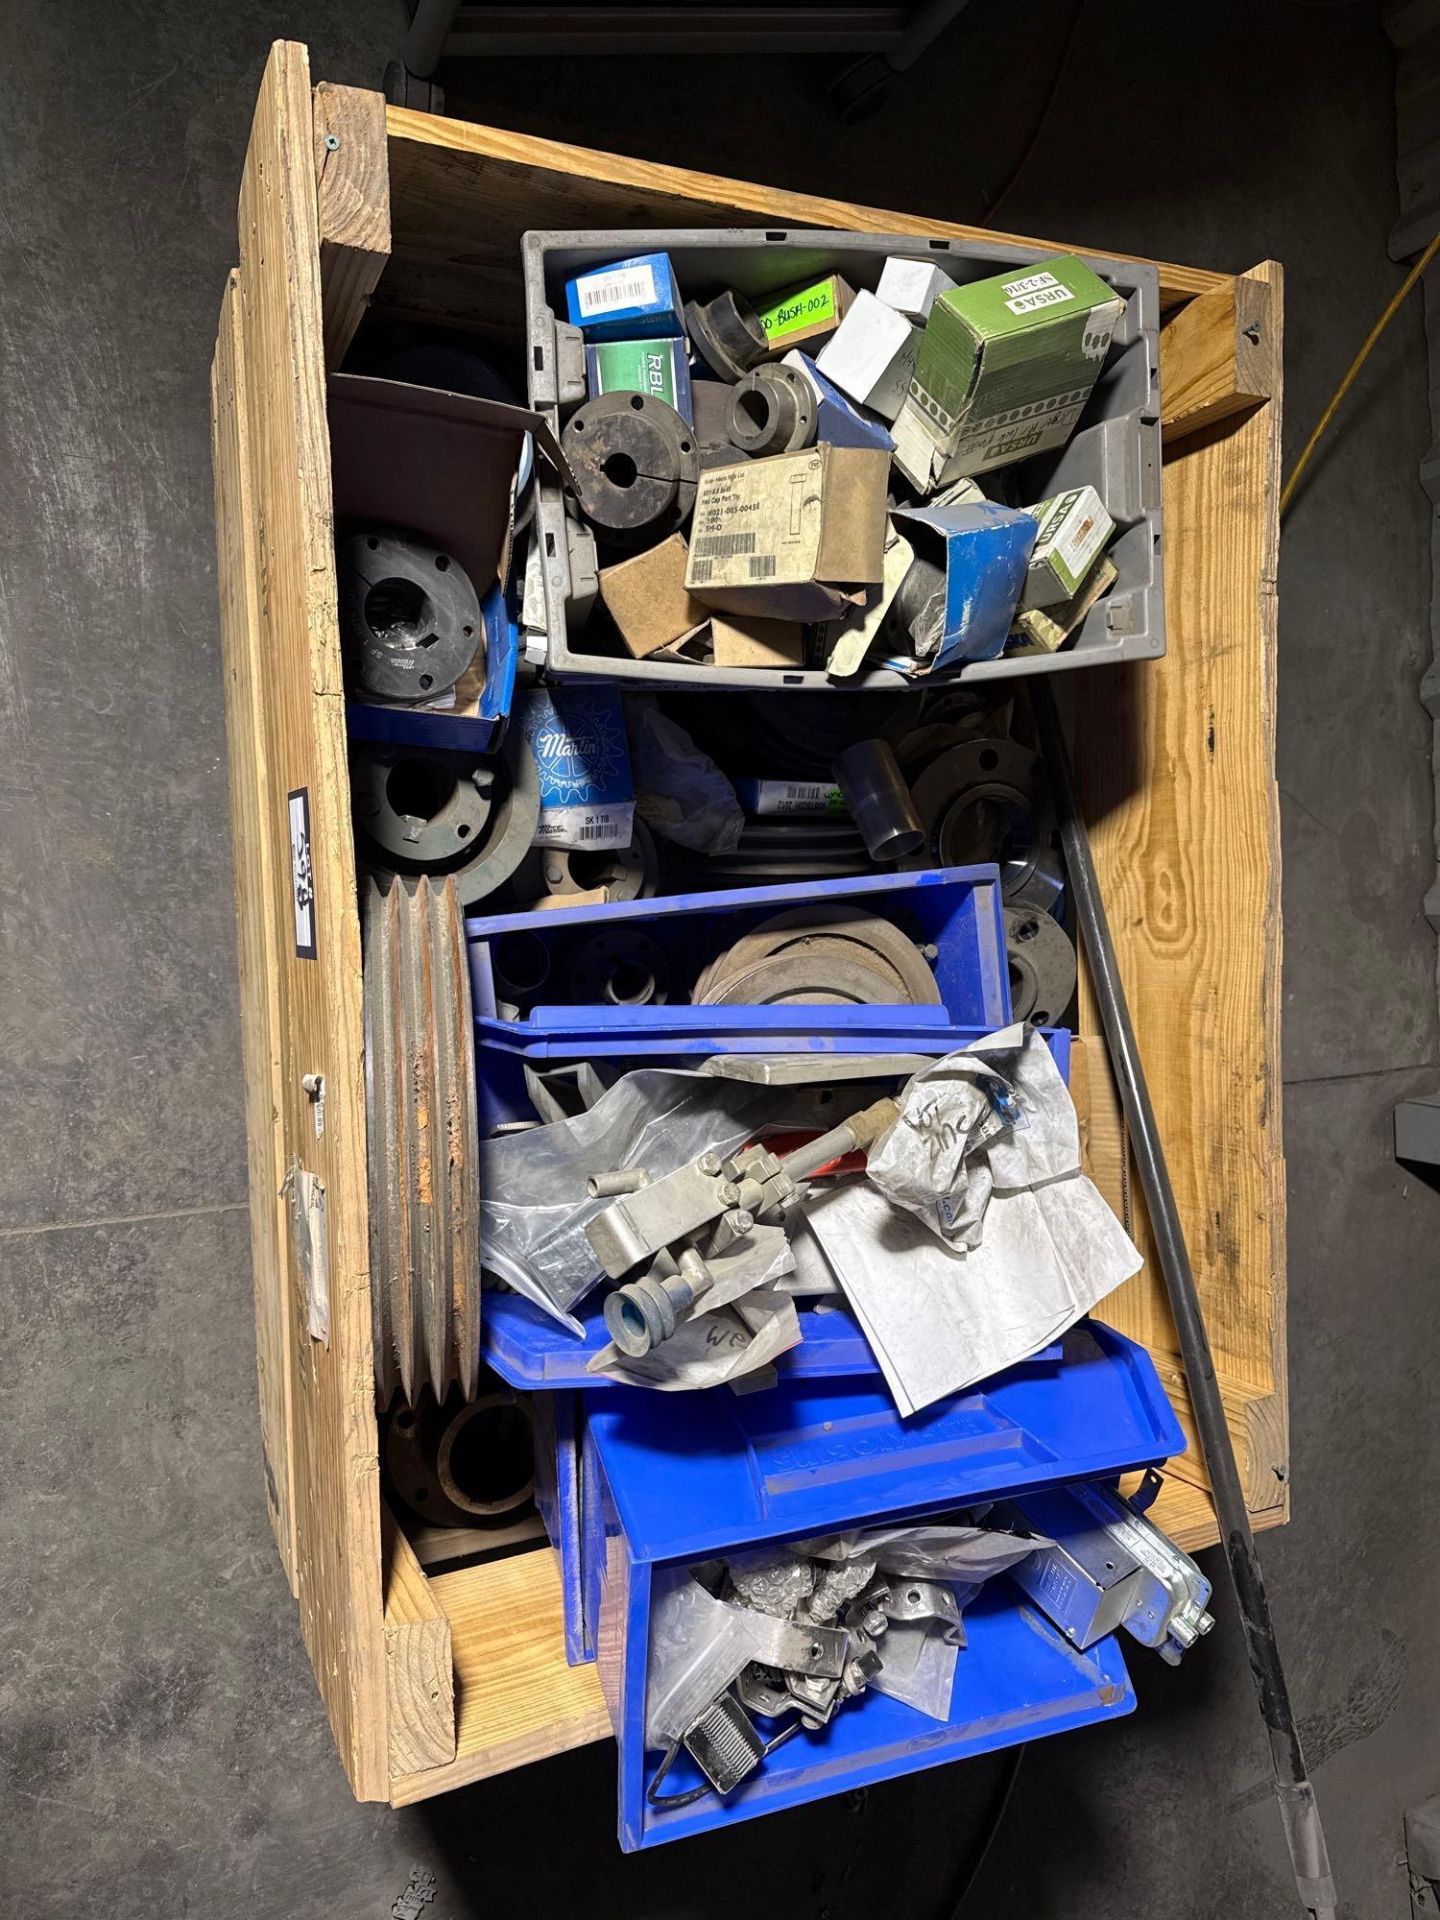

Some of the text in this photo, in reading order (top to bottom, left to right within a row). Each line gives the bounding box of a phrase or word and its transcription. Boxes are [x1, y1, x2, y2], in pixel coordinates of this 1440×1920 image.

[1004, 274, 1053, 294] SF-2-3/16
[1024, 288, 1068, 306] URSA
[1040, 503, 1072, 543] URSA
[540, 733, 596, 758] Martin
[585, 816, 594, 825] SK
